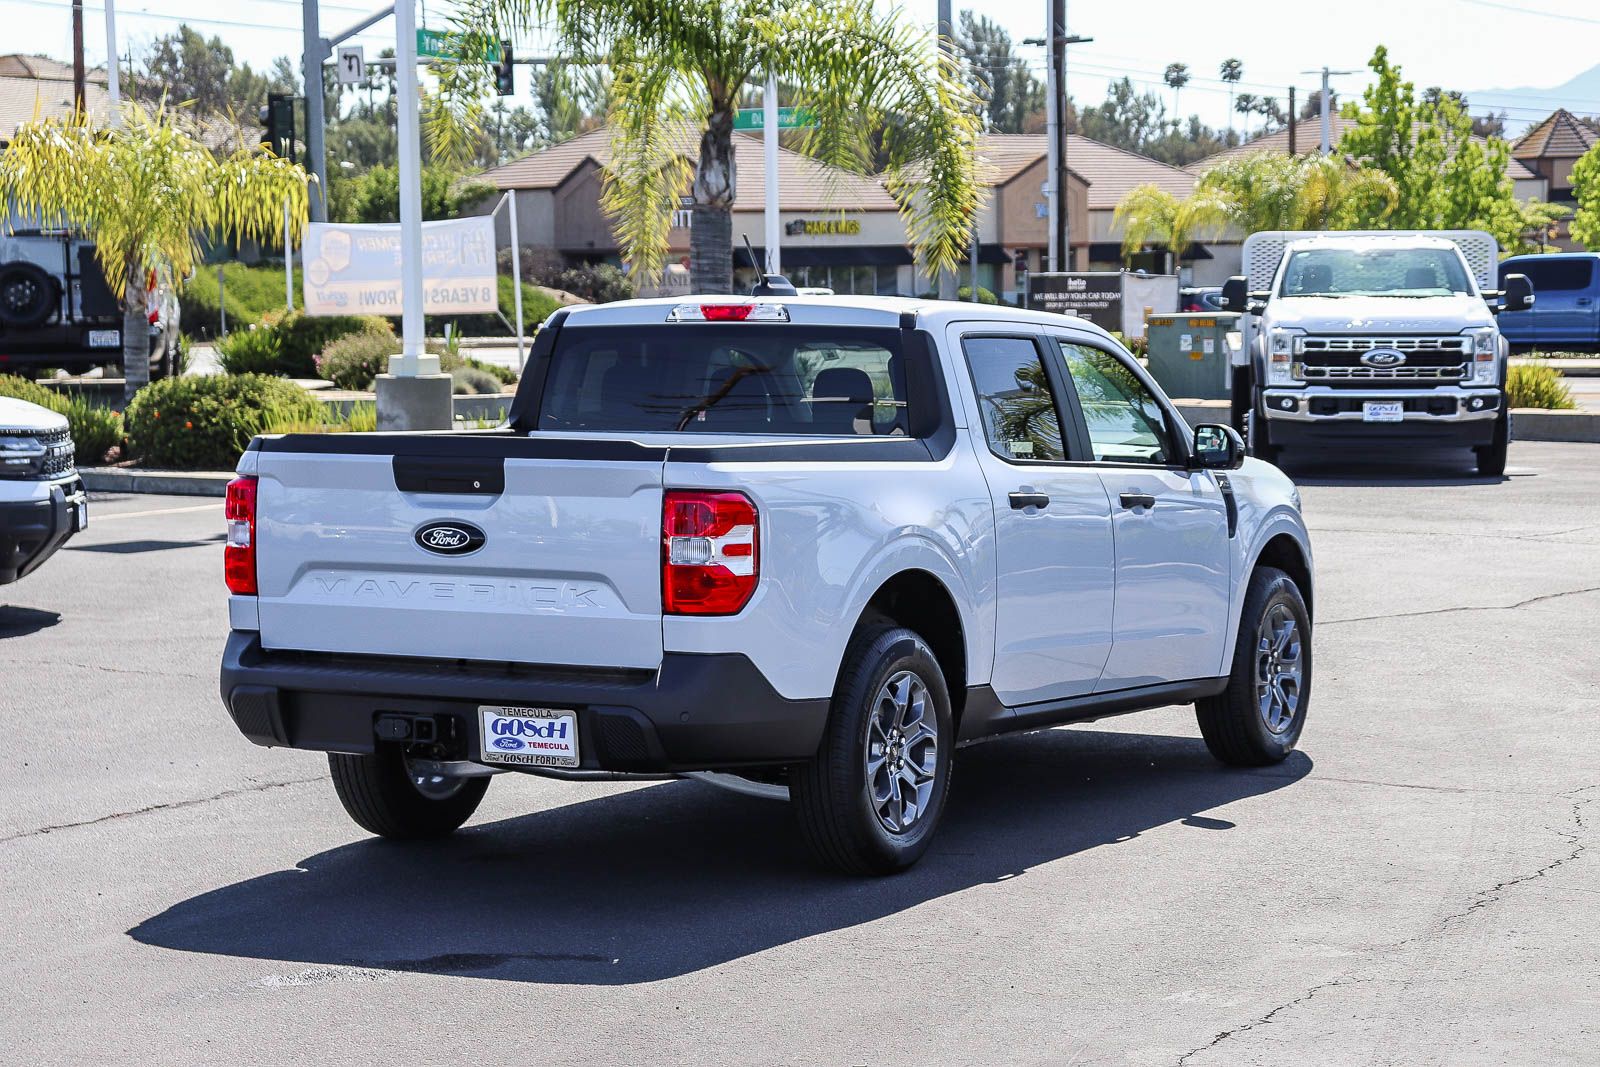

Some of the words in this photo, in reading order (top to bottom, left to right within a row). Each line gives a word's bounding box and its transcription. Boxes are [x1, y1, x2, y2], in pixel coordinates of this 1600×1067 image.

[430, 529, 460, 546] Ford
[314, 576, 604, 609] MAVERICK
[502, 707, 553, 718] TEMECULA
[528, 741, 569, 750] TEMECULA
